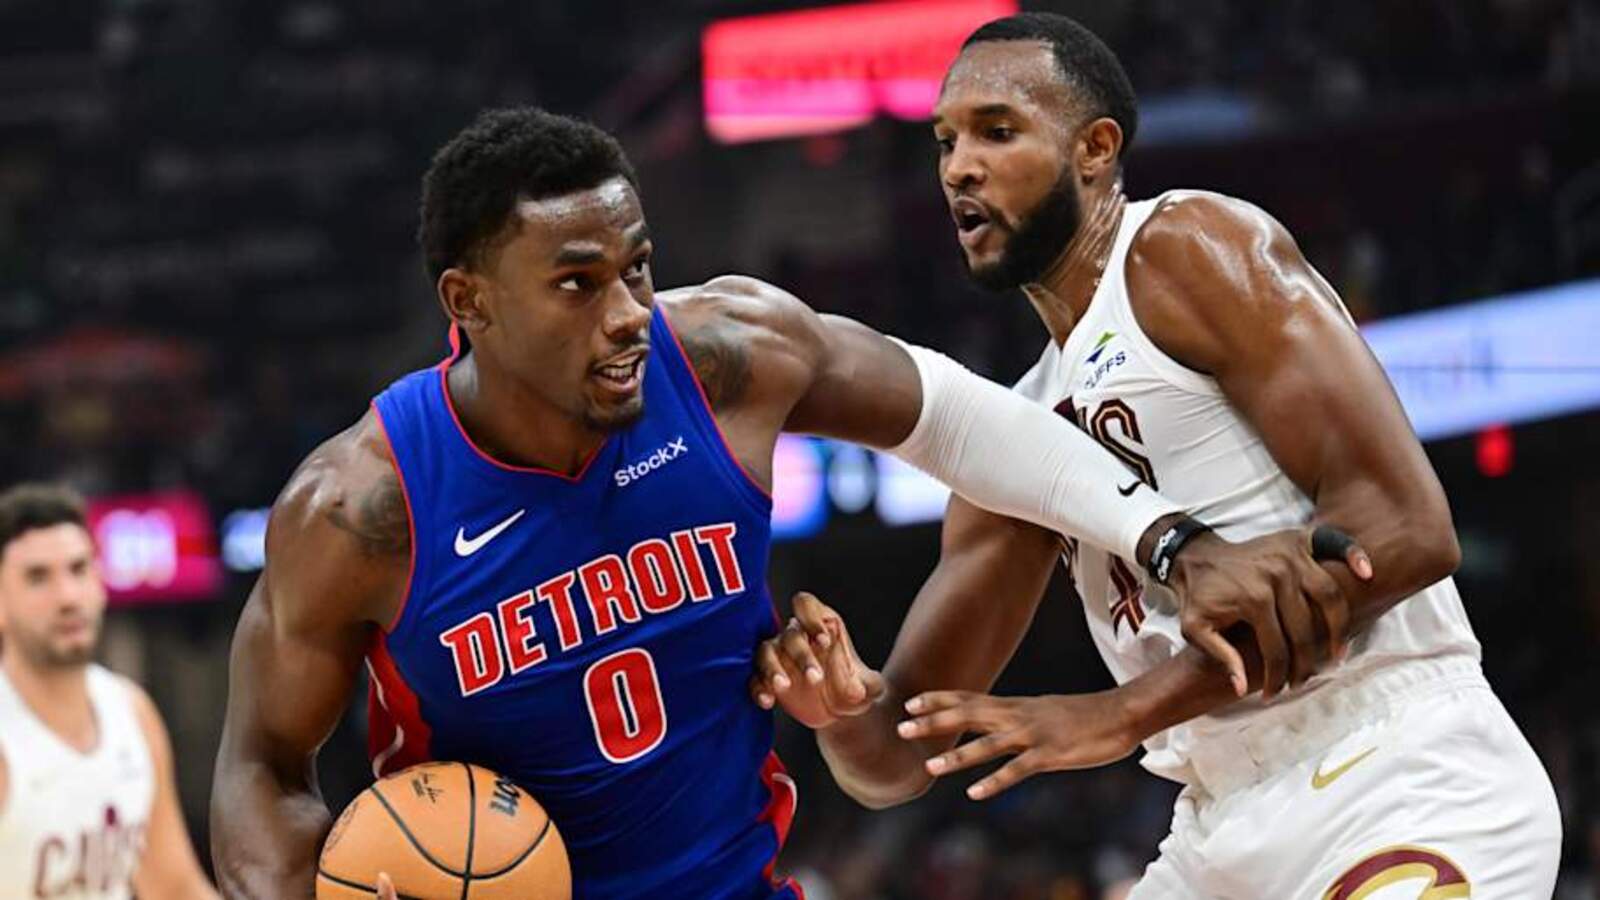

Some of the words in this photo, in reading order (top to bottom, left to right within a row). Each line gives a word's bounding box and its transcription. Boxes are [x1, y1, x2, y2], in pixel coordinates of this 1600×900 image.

[614, 436, 688, 487] StockX
[440, 522, 746, 697] DETROIT
[584, 648, 667, 764] 0
